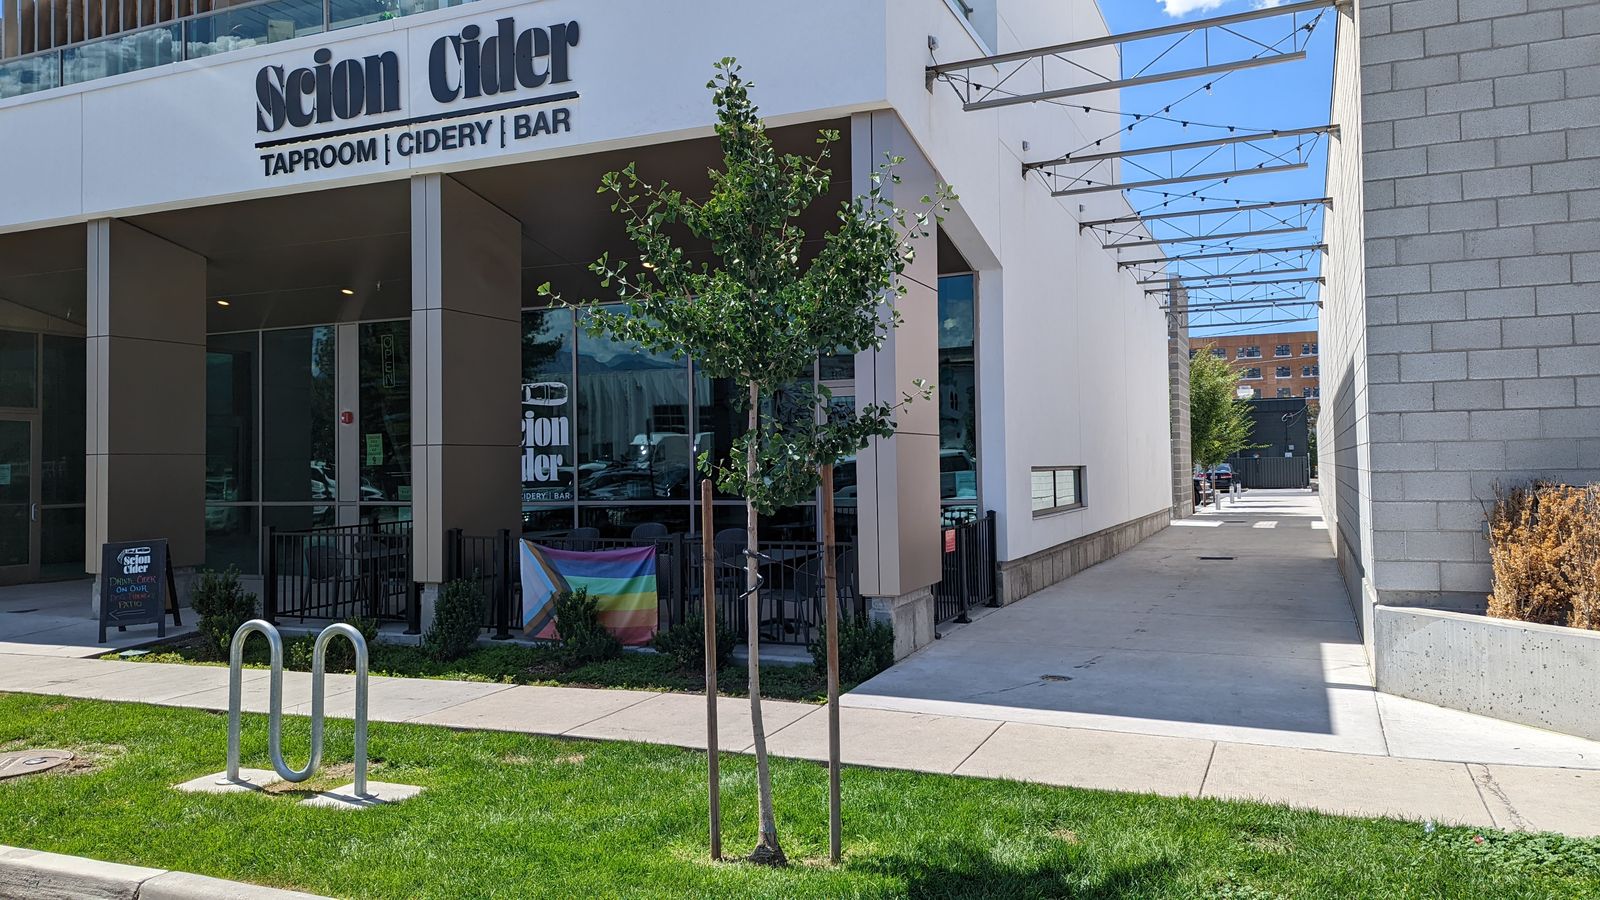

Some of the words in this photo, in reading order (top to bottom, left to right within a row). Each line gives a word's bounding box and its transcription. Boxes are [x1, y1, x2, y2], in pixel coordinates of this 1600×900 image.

[256, 47, 402, 134] Scion
[428, 16, 580, 104] Cider
[260, 137, 378, 177] TAPROOM
[396, 119, 493, 157] CIDERY
[513, 107, 571, 140] BAR
[383, 336, 394, 385] OPEN
[554, 492, 571, 500] BAR
[124, 555, 151, 565] Scion
[124, 565, 149, 574] Cider
[130, 585, 149, 593] OUR
